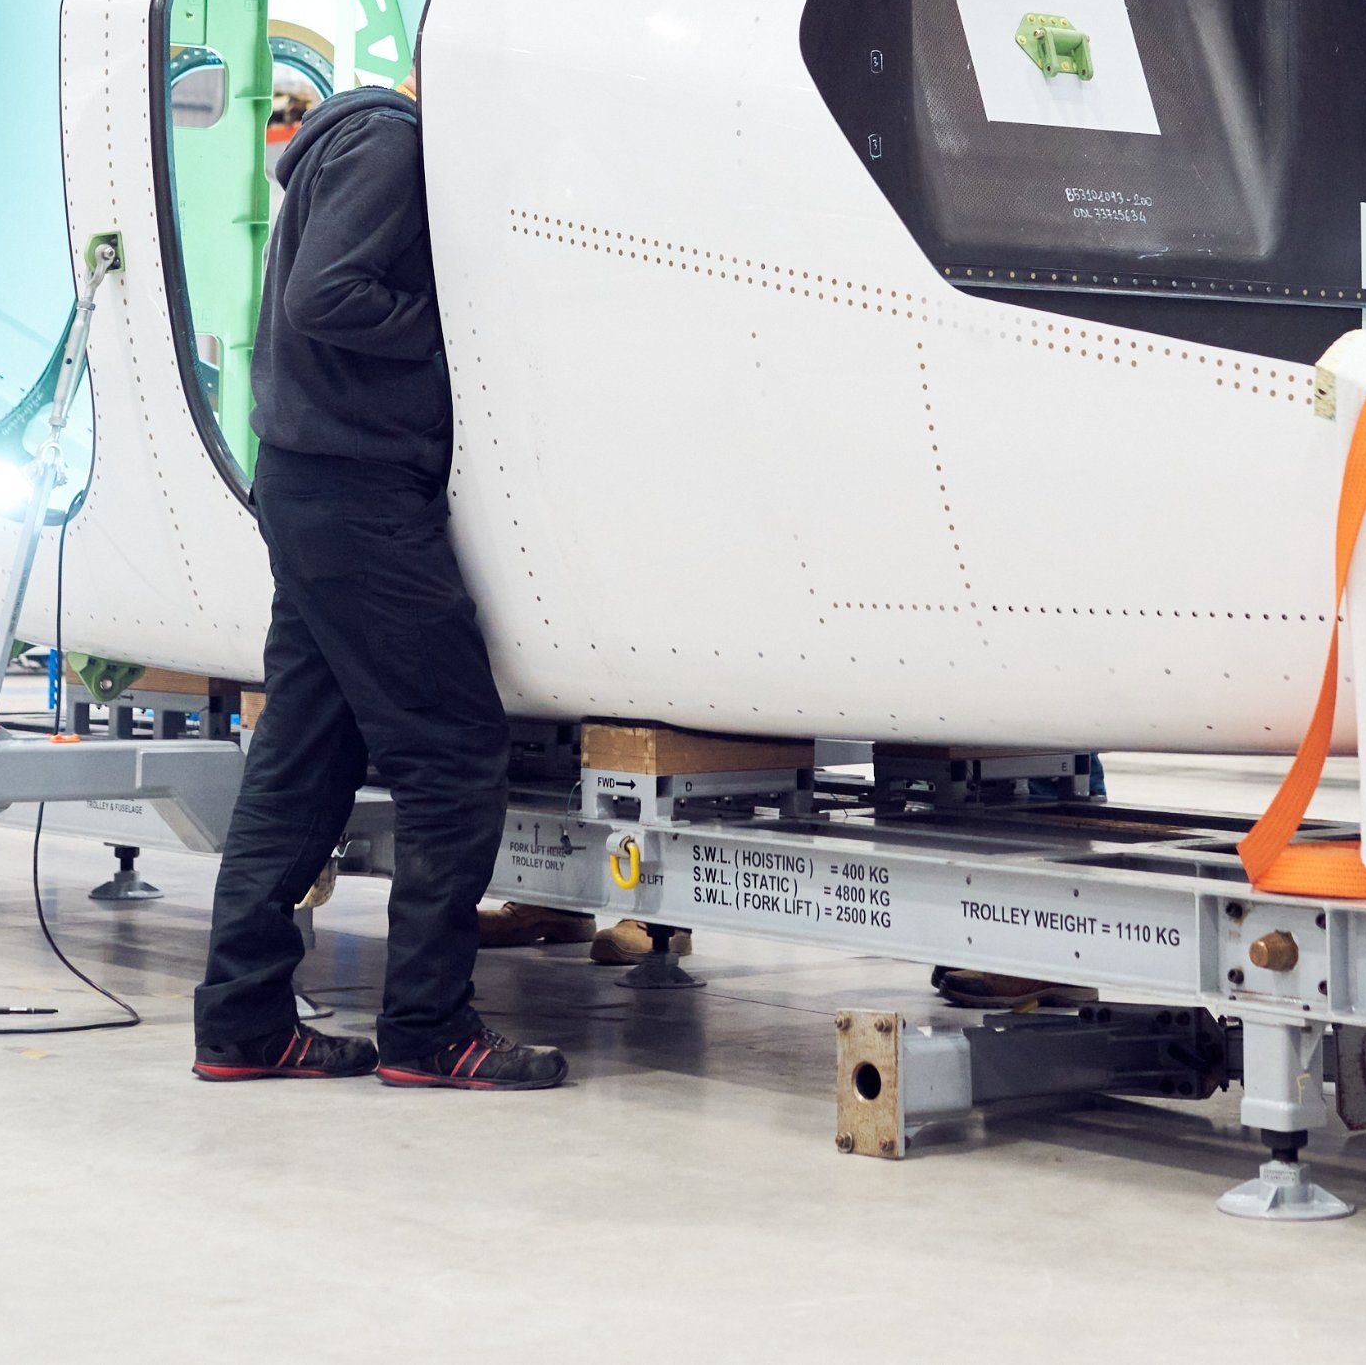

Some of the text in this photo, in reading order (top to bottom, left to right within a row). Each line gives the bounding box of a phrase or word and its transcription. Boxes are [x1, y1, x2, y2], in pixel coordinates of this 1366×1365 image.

[597, 777, 615, 788] FWD
[86, 799, 109, 810] TROLLEY
[115, 803, 143, 815] FUSELAGE
[509, 841, 567, 858] FORK LIFT HERE
[512, 855, 565, 872] TROLLEY ONLY
[692, 844, 731, 865] S.W.L.
[842, 863, 865, 881] 400
[869, 866, 889, 885] KG
[647, 875, 664, 886] LIFT
[693, 866, 731, 886] S.W.L.
[834, 884, 866, 904] 4800
[870, 888, 891, 907] KG
[694, 886, 732, 906] S.W.L.
[836, 905, 866, 925] 2500
[870, 910, 891, 928] KG
[960, 900, 1030, 926] TROLLEY
[1034, 910, 1097, 935] WEIGHT
[1115, 921, 1151, 943] 1110
[1156, 926, 1180, 947] KG
